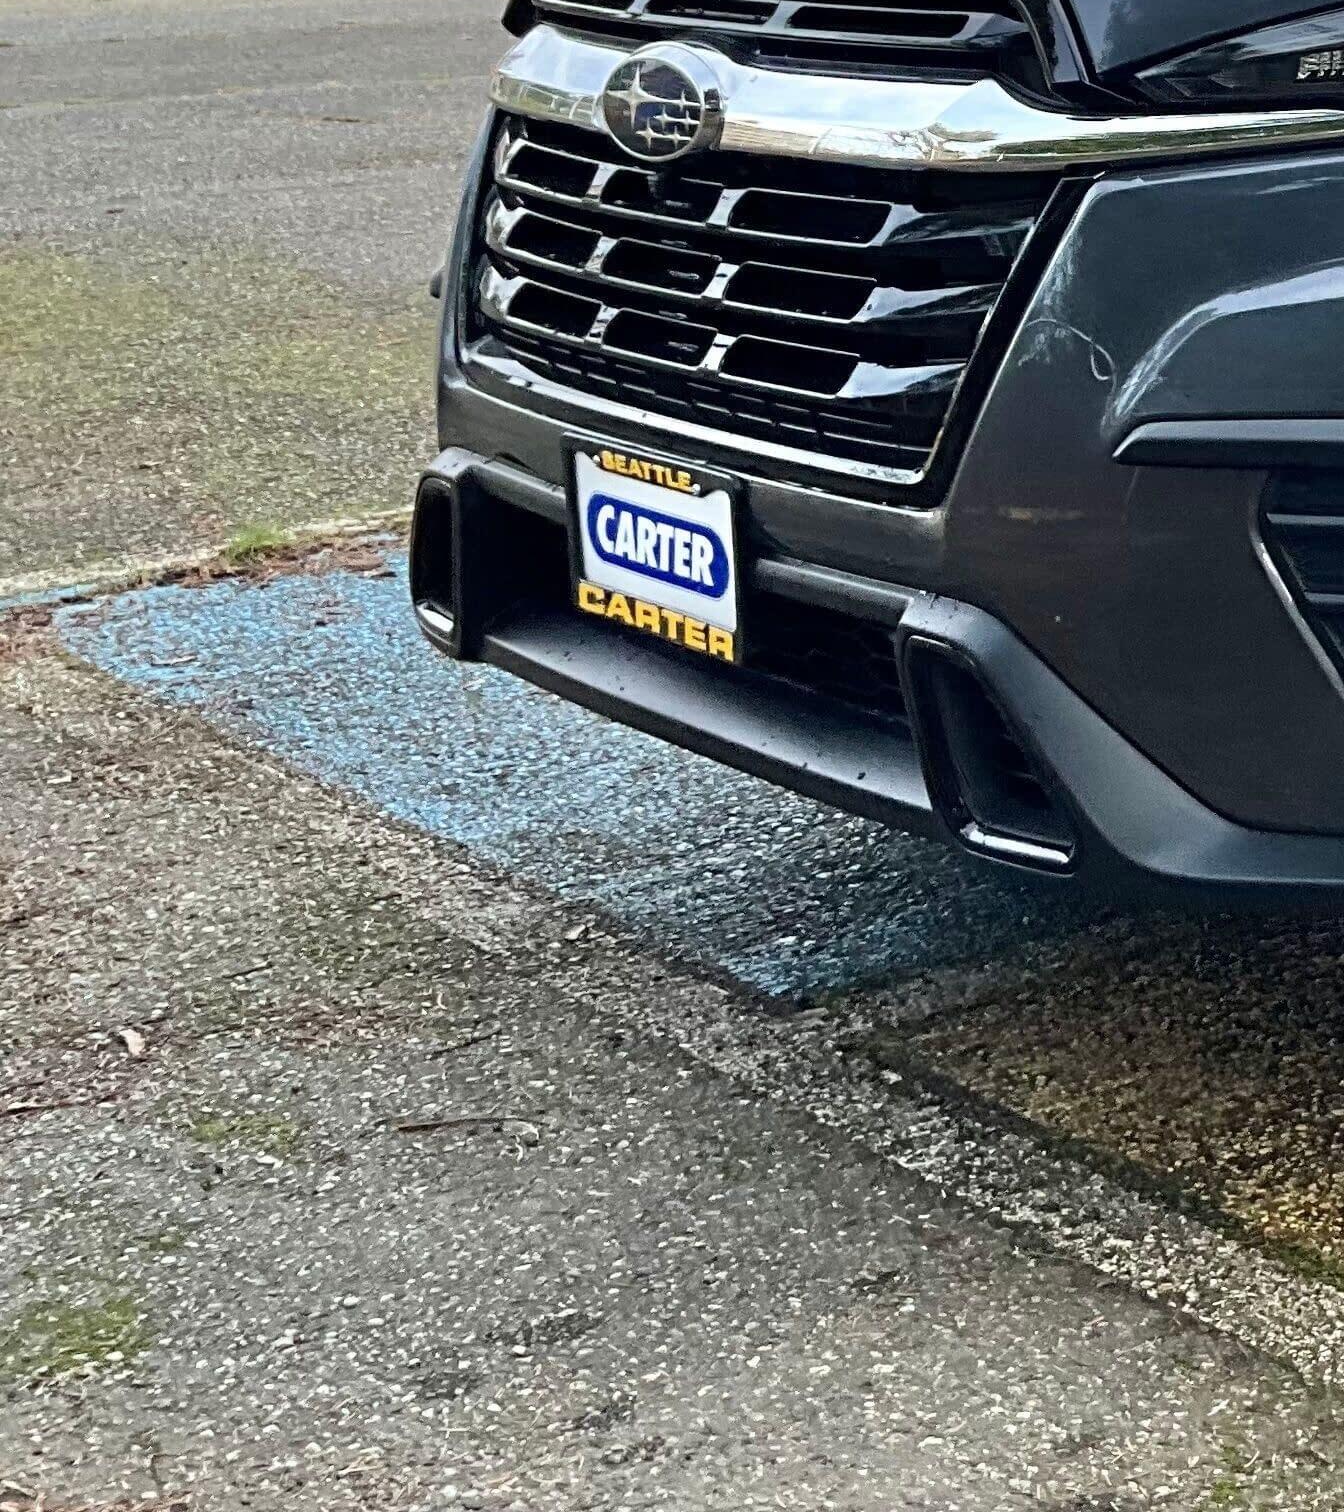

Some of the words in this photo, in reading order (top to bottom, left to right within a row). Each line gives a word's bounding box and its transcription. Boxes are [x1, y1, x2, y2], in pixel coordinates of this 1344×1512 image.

[600, 450, 693, 492] SEATTLE
[596, 505, 714, 587] CARTER
[578, 582, 734, 662] CARTER
